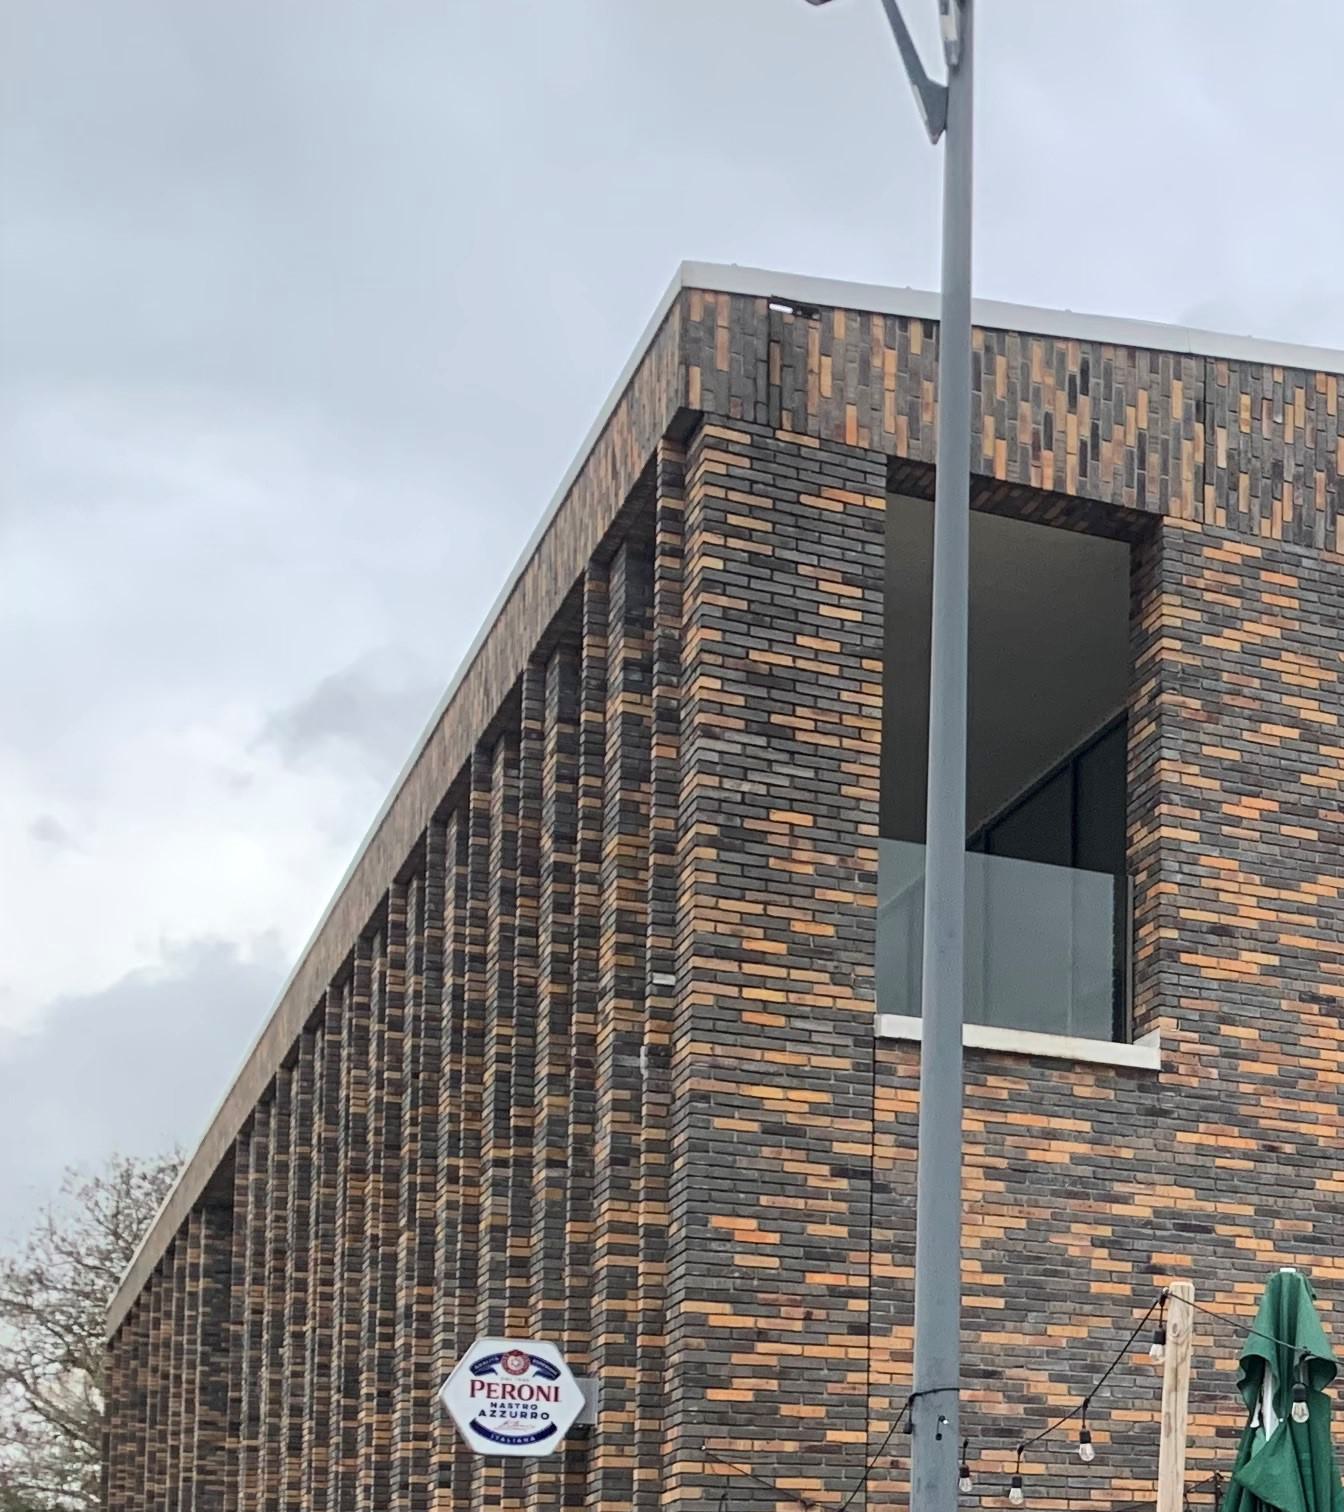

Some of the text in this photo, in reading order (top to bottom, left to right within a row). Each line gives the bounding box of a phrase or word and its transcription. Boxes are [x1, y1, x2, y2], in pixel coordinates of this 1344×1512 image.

[469, 1379, 561, 1403] PERONI
[490, 1402, 538, 1411] NASTRO
[478, 1409, 550, 1421] AZZURRO
[490, 1434, 536, 1444] ITALIANA
